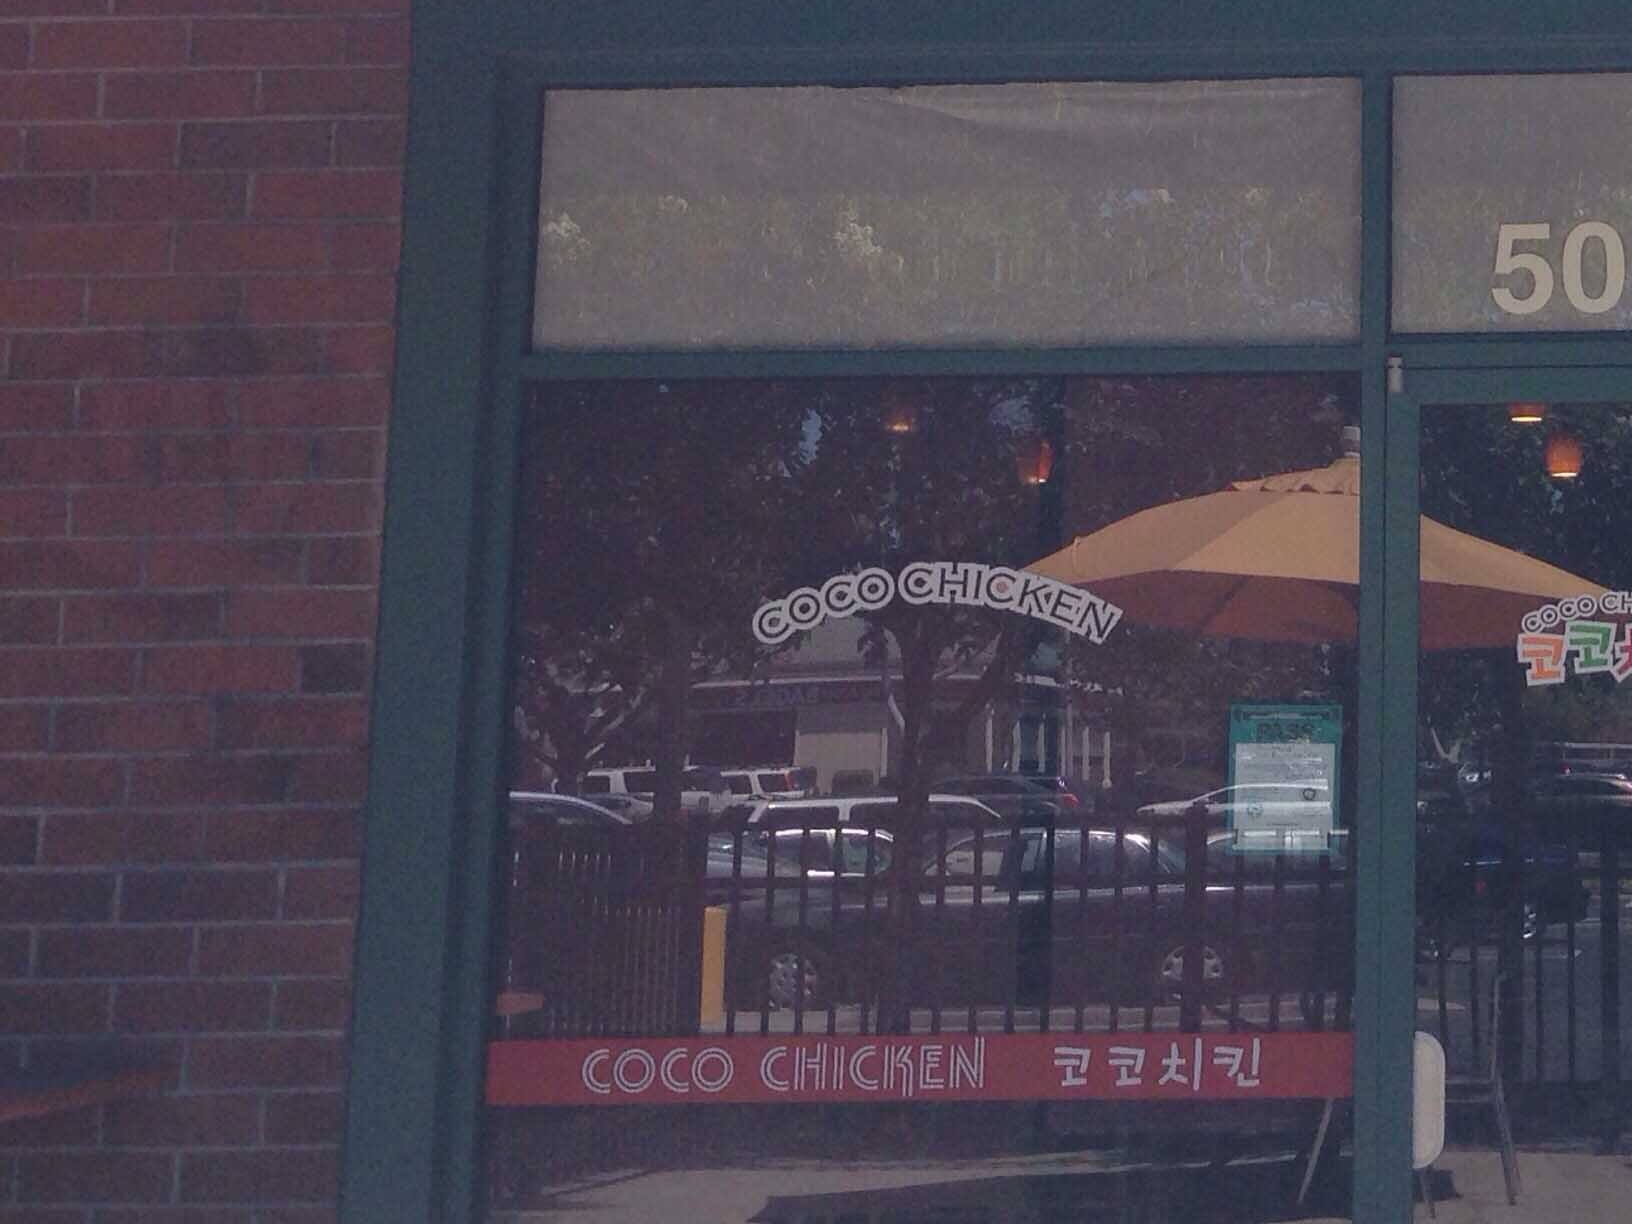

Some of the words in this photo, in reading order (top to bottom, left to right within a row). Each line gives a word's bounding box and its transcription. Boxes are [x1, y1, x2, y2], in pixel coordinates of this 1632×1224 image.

[754, 568, 893, 643] COCO
[900, 563, 1121, 643] CHICKEN
[1523, 595, 1596, 633] COCO
[581, 1047, 734, 1094] COCO
[759, 1036, 985, 1097] CHICKEN
[1052, 1037, 1261, 1091] 코코치킨
